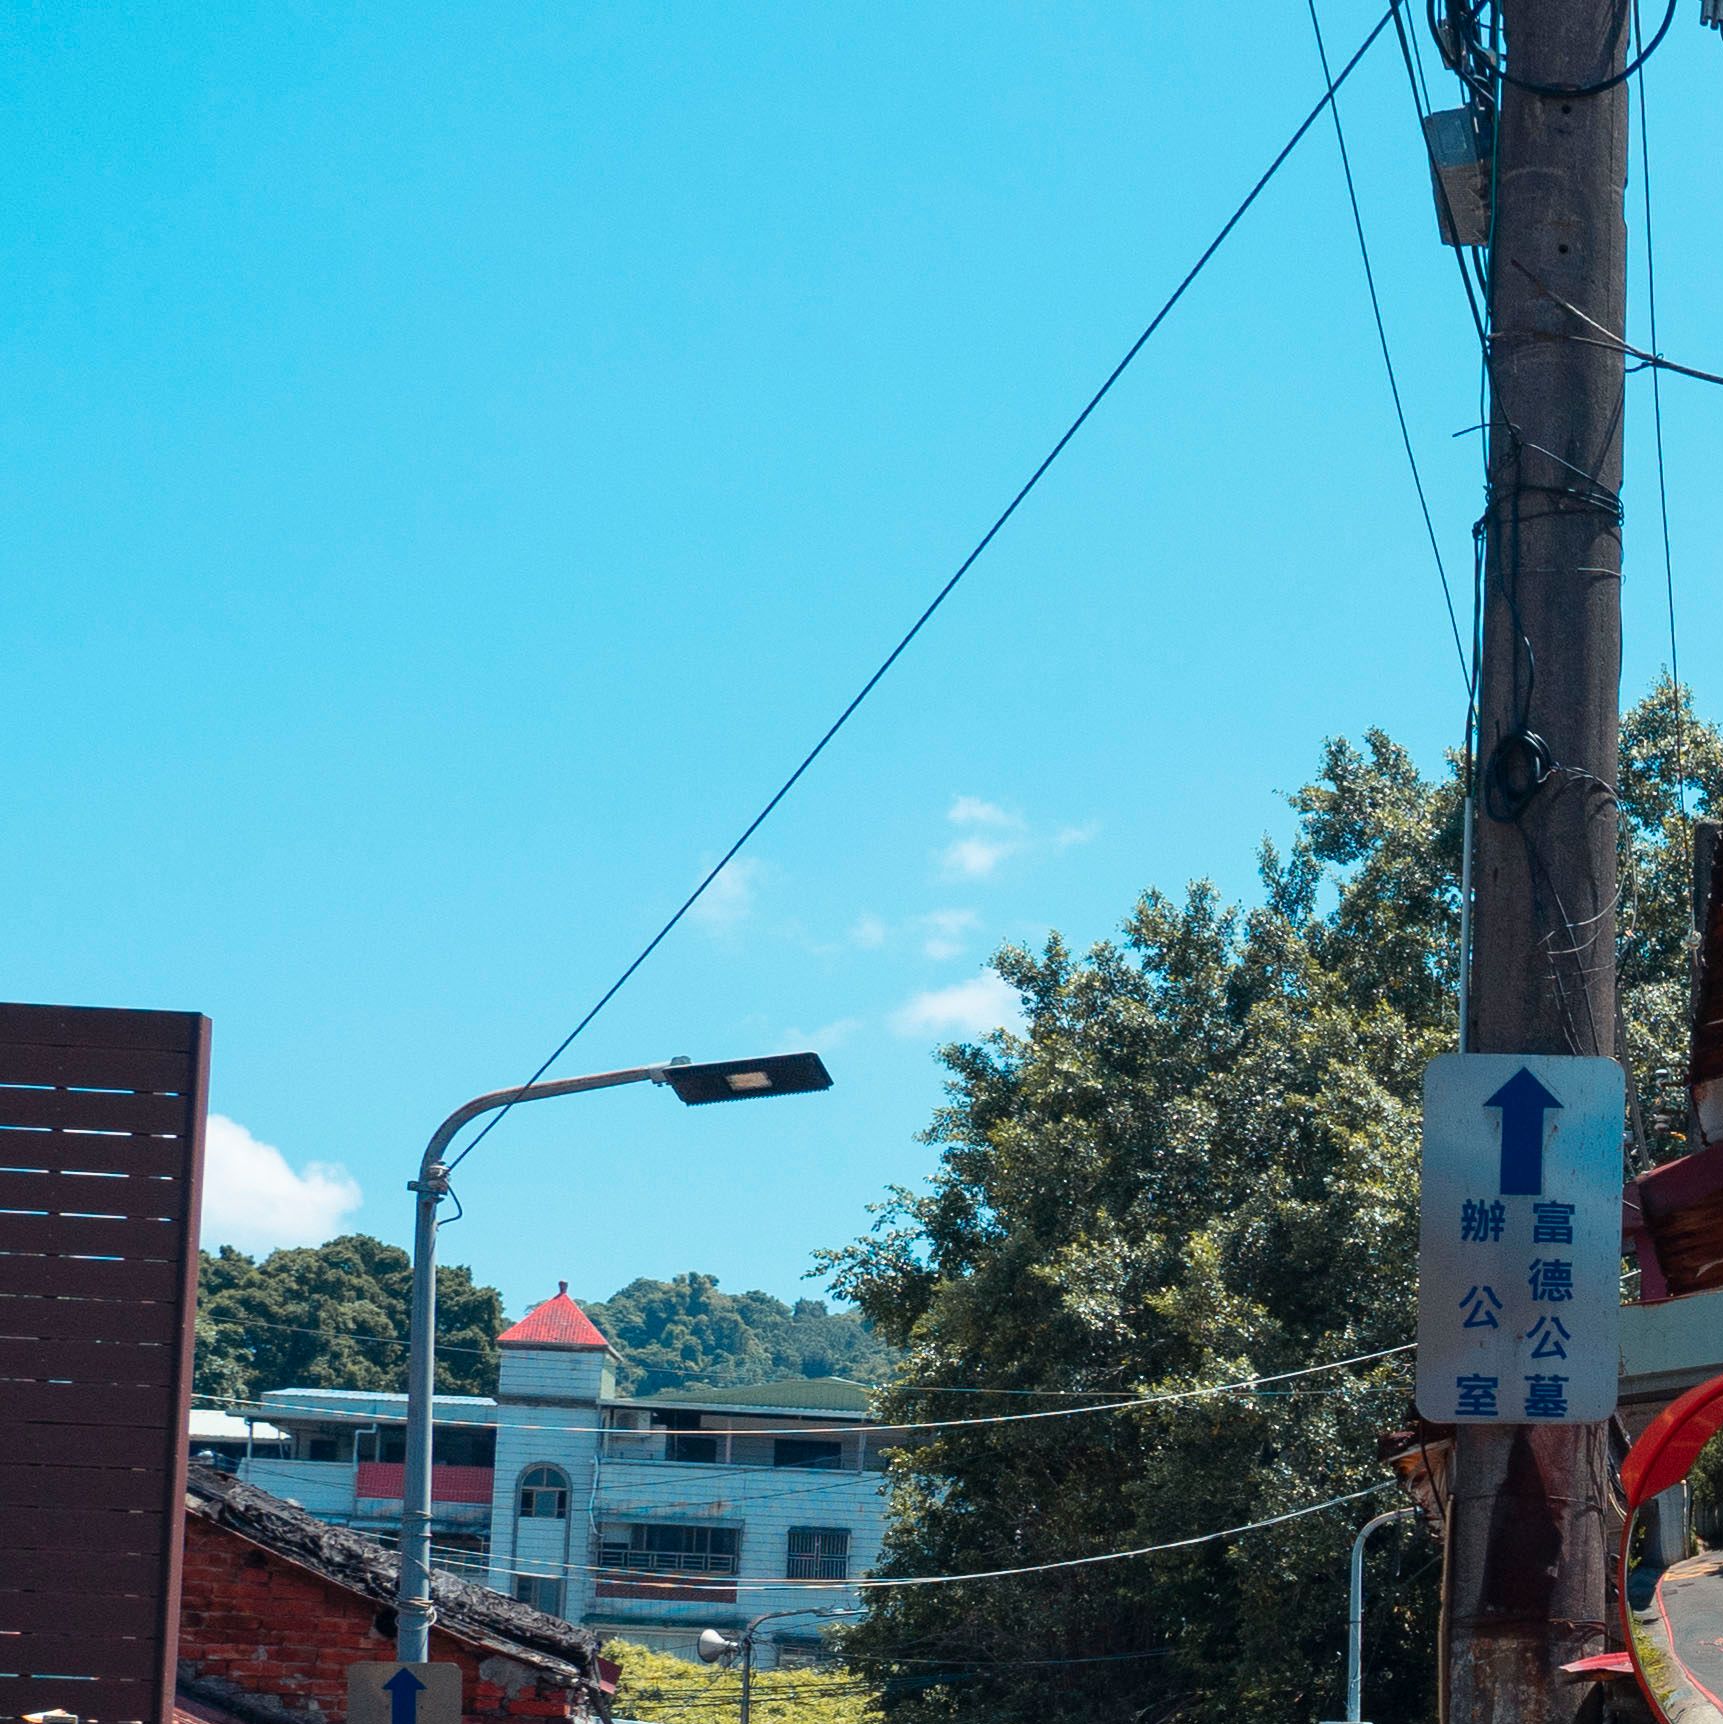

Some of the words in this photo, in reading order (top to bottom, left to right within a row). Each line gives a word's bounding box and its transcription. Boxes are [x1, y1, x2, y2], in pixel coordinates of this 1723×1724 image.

[1456, 1198, 1505, 1417] 辦公室
[1524, 1201, 1575, 1417] 富德公墓
